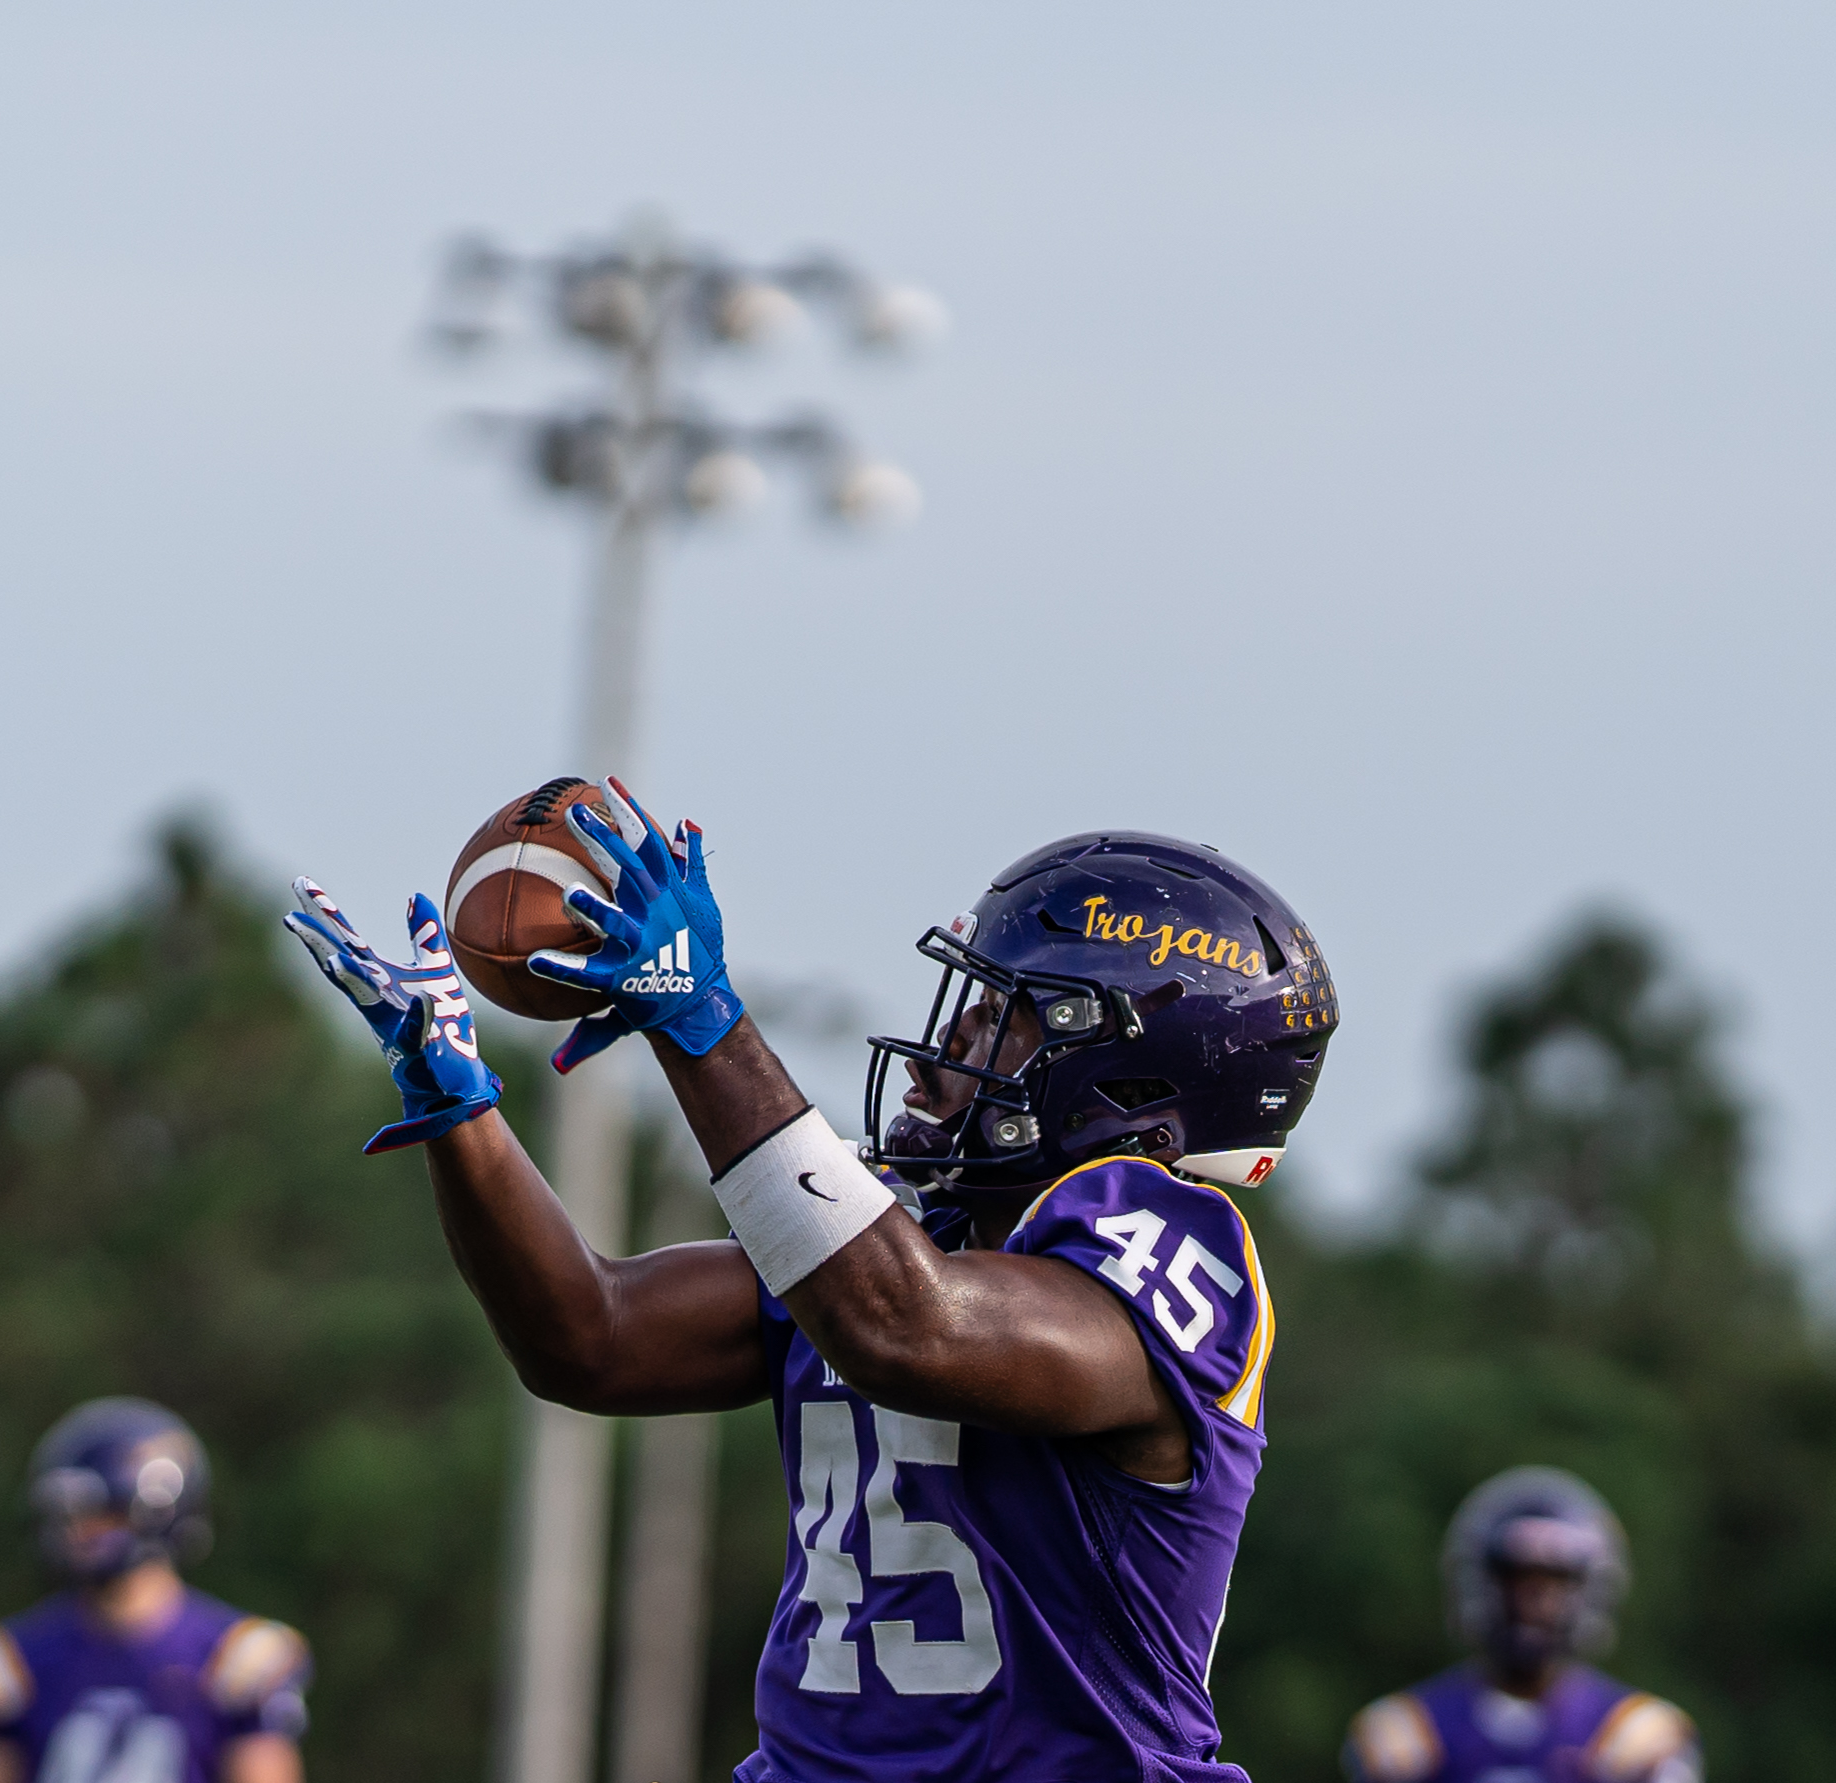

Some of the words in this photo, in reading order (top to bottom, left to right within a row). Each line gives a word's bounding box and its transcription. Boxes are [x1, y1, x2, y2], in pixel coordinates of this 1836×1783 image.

[622, 974, 695, 994] adidas
[1083, 895, 1264, 977] Trojans
[1096, 1208, 1244, 1354] 45
[795, 1401, 1002, 1694] 45
